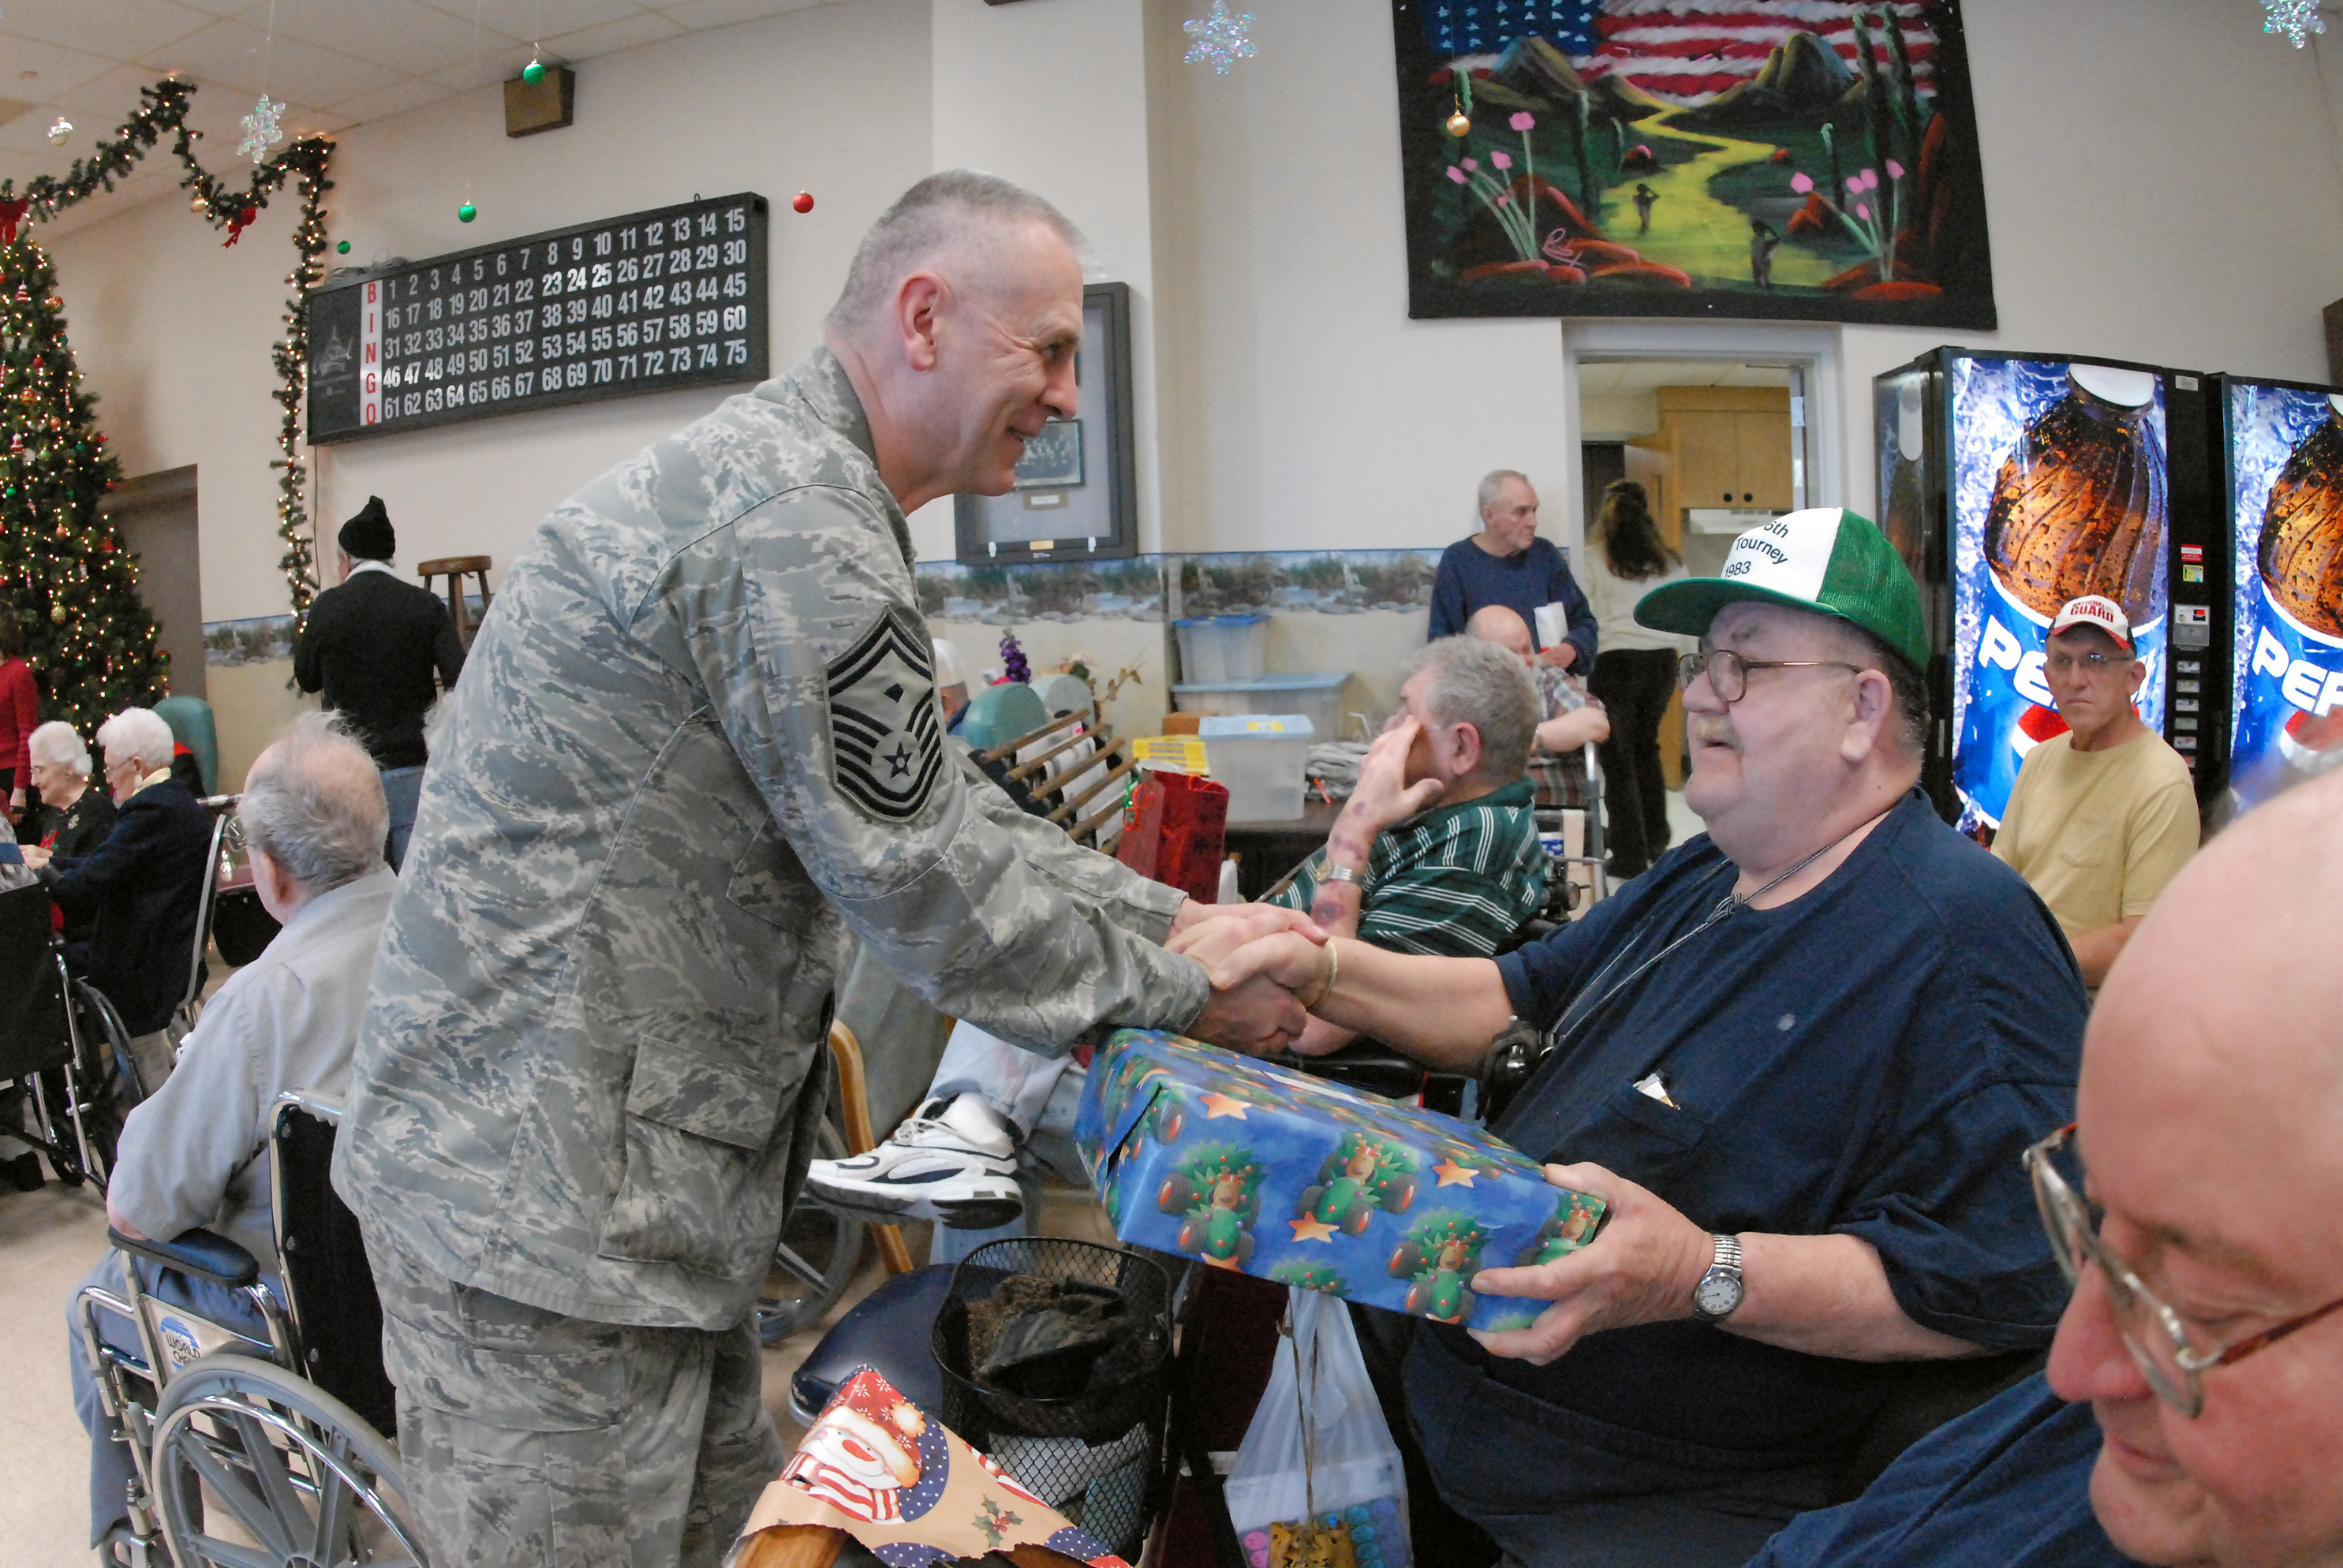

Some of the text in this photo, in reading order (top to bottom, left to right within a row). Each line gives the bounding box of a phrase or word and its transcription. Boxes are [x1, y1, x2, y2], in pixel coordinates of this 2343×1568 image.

[385, 239, 746, 330] 16 17 18 19 20 21 22 23 24 25 26 27 28 29 30
[389, 207, 746, 300] 1 2 3 4 5 6 7 8 9 10 11 12 13 14 15
[383, 364, 402, 389] 46
[403, 360, 421, 386] 47
[424, 357, 443, 381] 48
[446, 352, 465, 376] 49
[469, 348, 488, 373] 50
[493, 344, 510, 368] 51
[514, 339, 534, 364] 52
[542, 334, 562, 360] 53
[566, 330, 587, 356] 54
[592, 326, 613, 352] 55
[616, 321, 638, 348] 56
[643, 317, 664, 344] 57
[668, 313, 691, 340] 58
[696, 308, 719, 336] 59
[723, 304, 747, 332] 60
[384, 336, 400, 360] 31
[404, 331, 422, 356] 32
[425, 327, 443, 352] 33
[447, 323, 465, 347] 34
[469, 318, 488, 342] 35
[491, 313, 511, 338] 36
[514, 308, 534, 334] 37
[541, 303, 562, 328] 38
[566, 298, 587, 324] 39
[591, 293, 613, 319] 40
[618, 289, 638, 314] 41
[642, 284, 665, 311] 42
[669, 280, 693, 306] 43
[695, 276, 719, 302] 44
[723, 271, 747, 298] 45
[384, 338, 747, 420] 61 62 63 64 65 66 67 68 69 70 71 72 73 74 75
[1725, 561, 1751, 579] 1983
[1736, 537, 1788, 565] Tourney
[2070, 605, 2113, 623] GUARD
